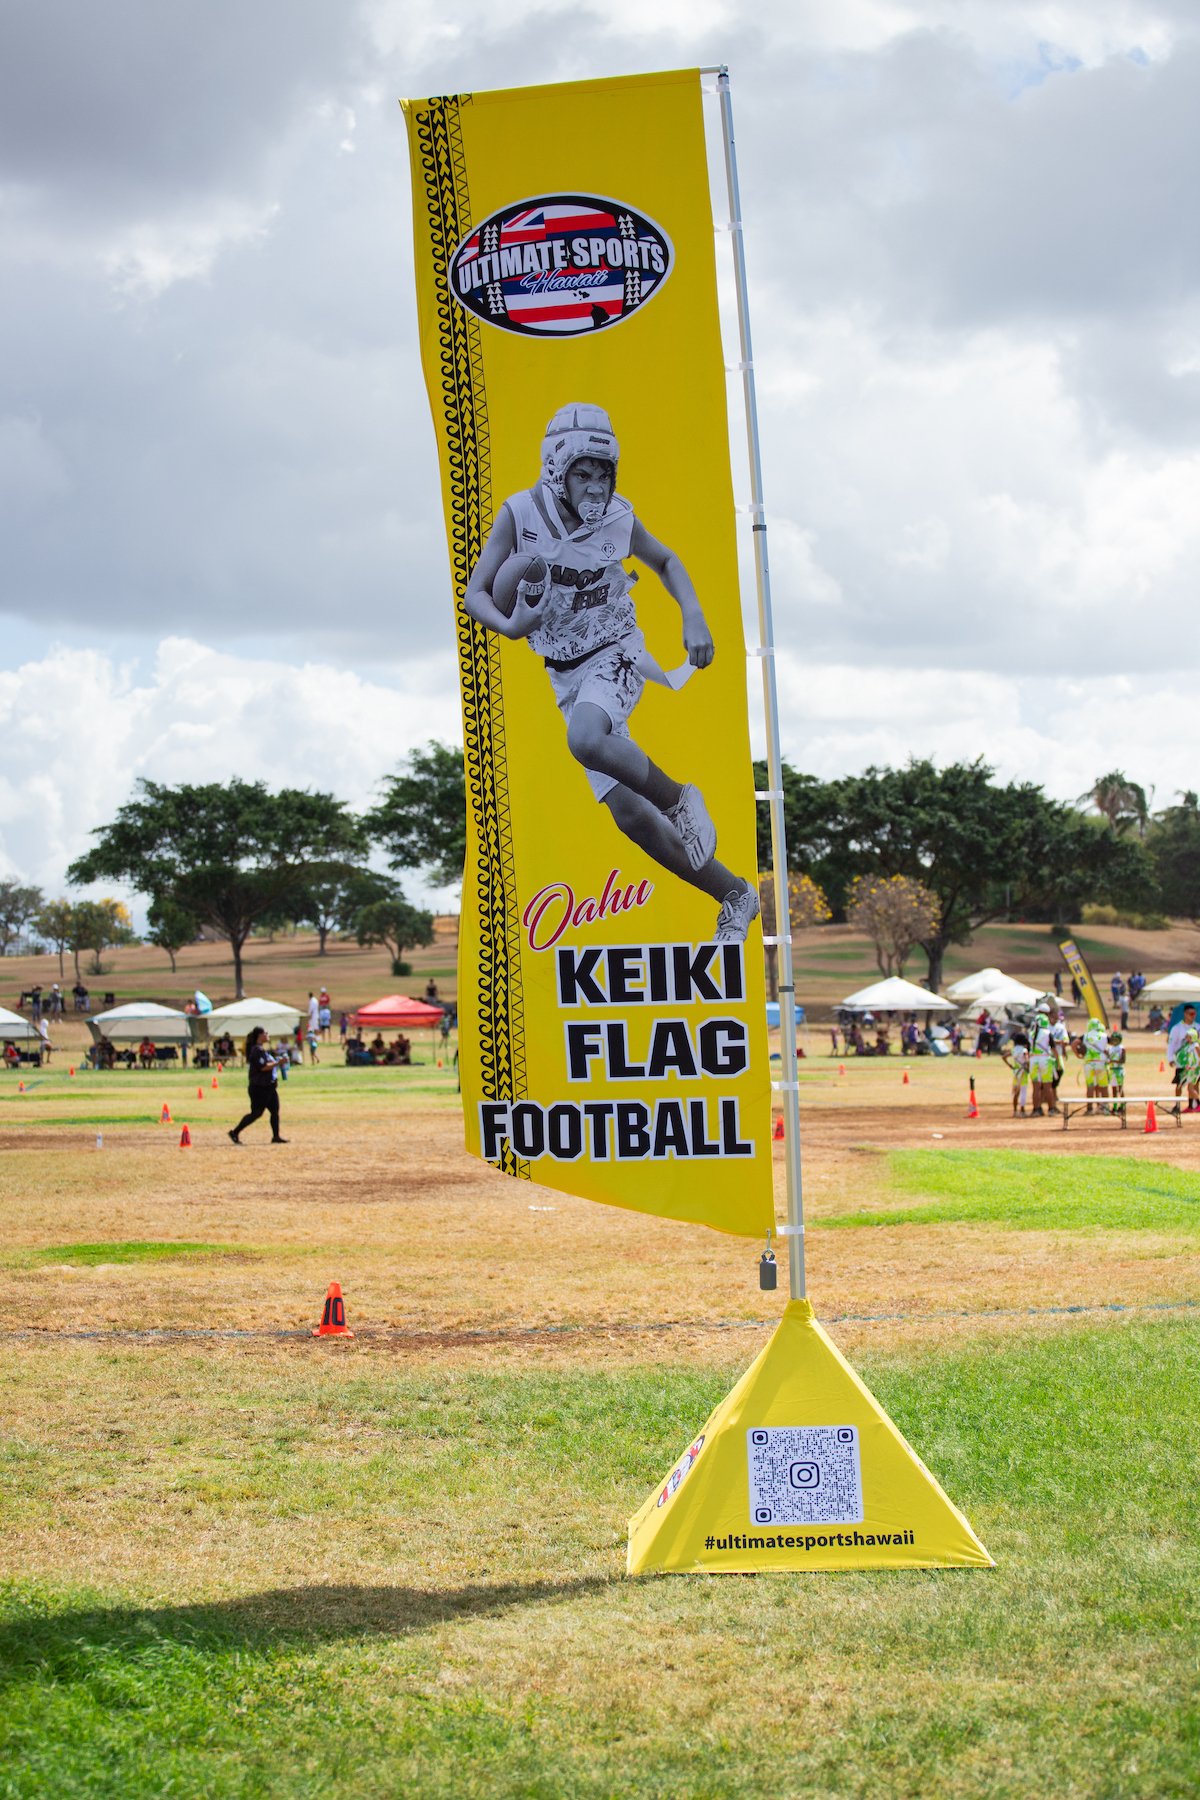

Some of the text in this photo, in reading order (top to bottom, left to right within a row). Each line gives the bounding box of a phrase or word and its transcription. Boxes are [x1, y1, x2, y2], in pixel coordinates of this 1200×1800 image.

[458, 237, 664, 294] ULTIMATE SPORTS
[520, 268, 608, 295] Hawaii
[522, 870, 653, 950] Oahu
[556, 942, 746, 1006] KEIKI
[565, 1017, 748, 1082] FLAG
[478, 1097, 755, 1161] FOOTBALL
[322, 1297, 346, 1326] 10
[704, 1530, 914, 1550] #ultimatesportshawaii
